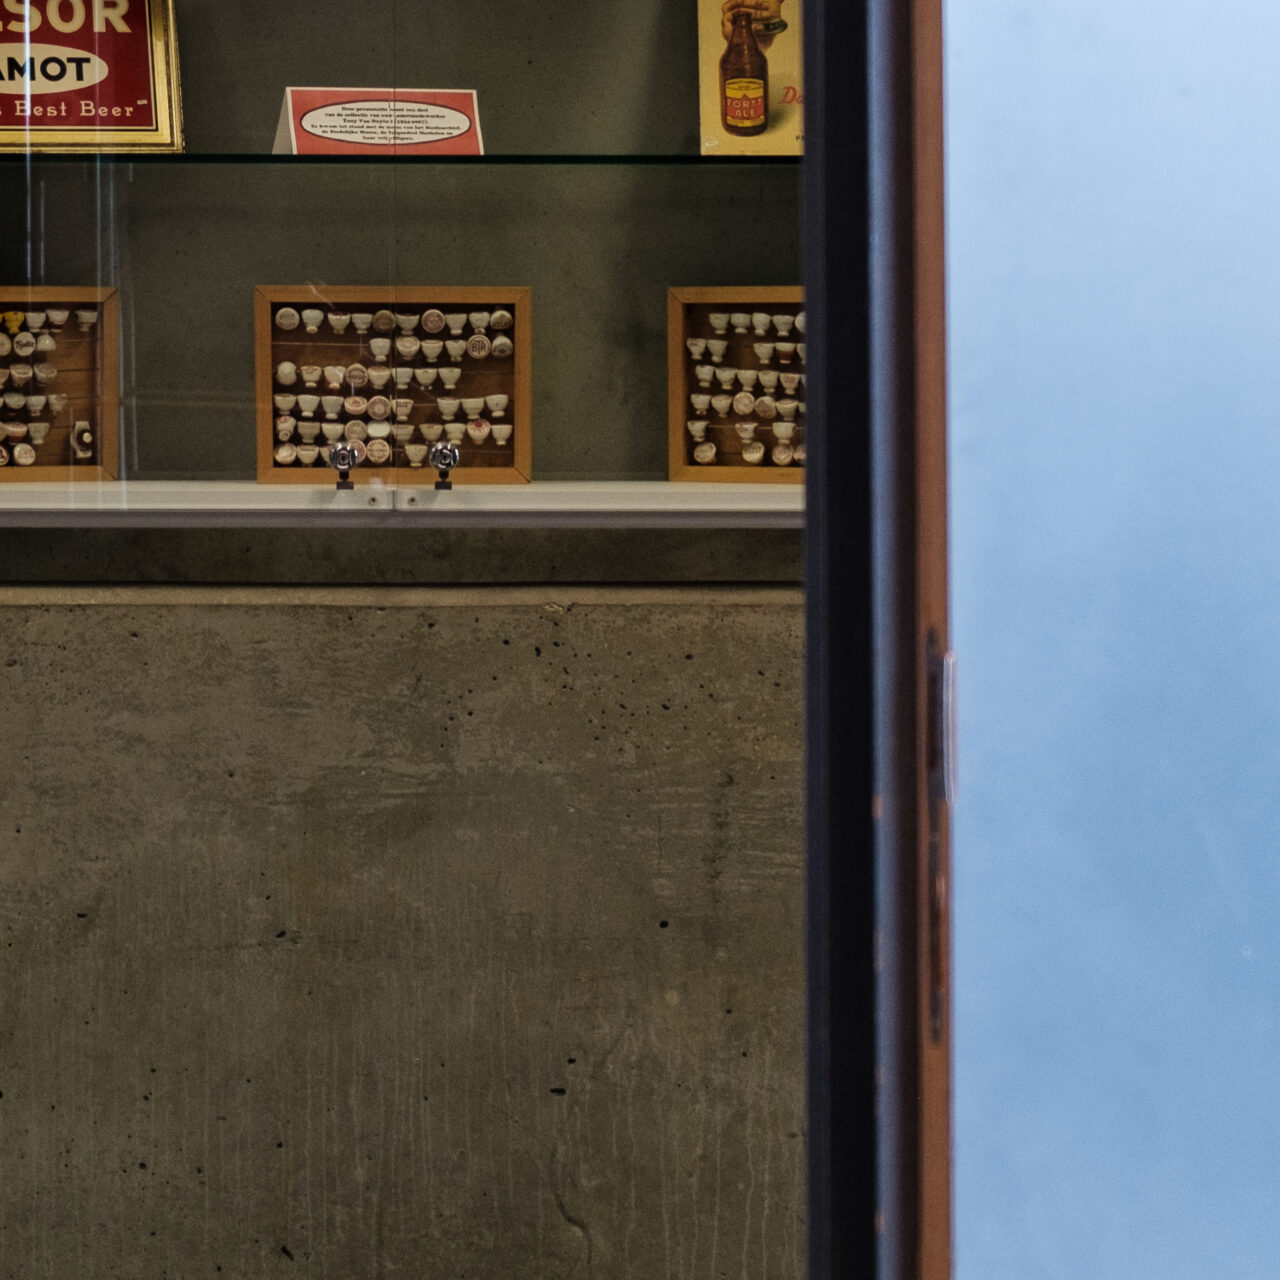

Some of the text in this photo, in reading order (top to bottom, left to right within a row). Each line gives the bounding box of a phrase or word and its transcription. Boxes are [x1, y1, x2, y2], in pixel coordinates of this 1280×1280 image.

[14, 100, 67, 117] Best
[80, 100, 135, 118] Beer
[735, 108, 756, 117] ALE
